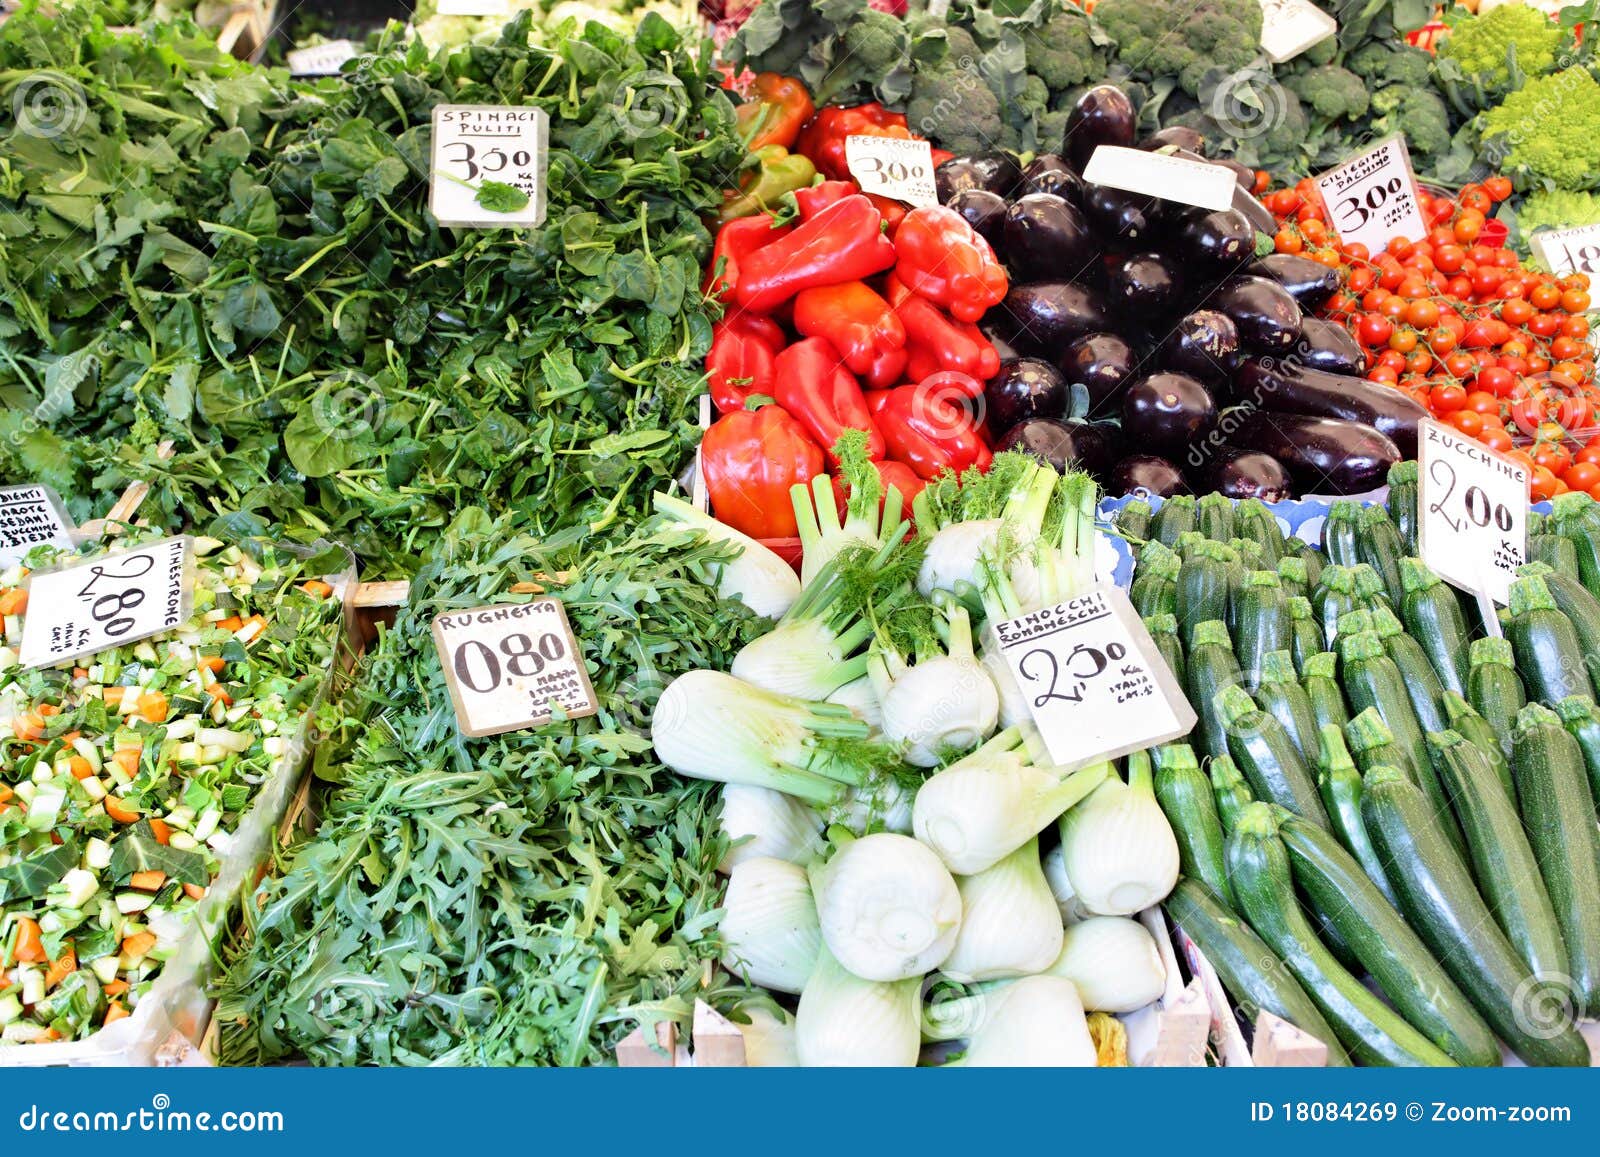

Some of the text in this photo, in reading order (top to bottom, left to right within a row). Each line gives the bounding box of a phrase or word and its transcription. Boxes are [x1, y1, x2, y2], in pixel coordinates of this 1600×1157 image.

[442, 112, 535, 122] SPINACI
[460, 123, 521, 133] PULITI
[851, 135, 927, 151] PEPERONI
[1321, 146, 1389, 188] CILIEGINO
[1336, 155, 1389, 190] PACHINO
[1428, 427, 1525, 483] ZUCCHINE
[165, 542, 184, 627] MINESTRONE
[438, 602, 557, 631] RUGHETTA
[996, 593, 1103, 634] FINOCCHI
[999, 603, 1107, 644] ROMANESCHI
[529, 679, 579, 698] ITALIA
[1109, 675, 1148, 694] ITALIA
